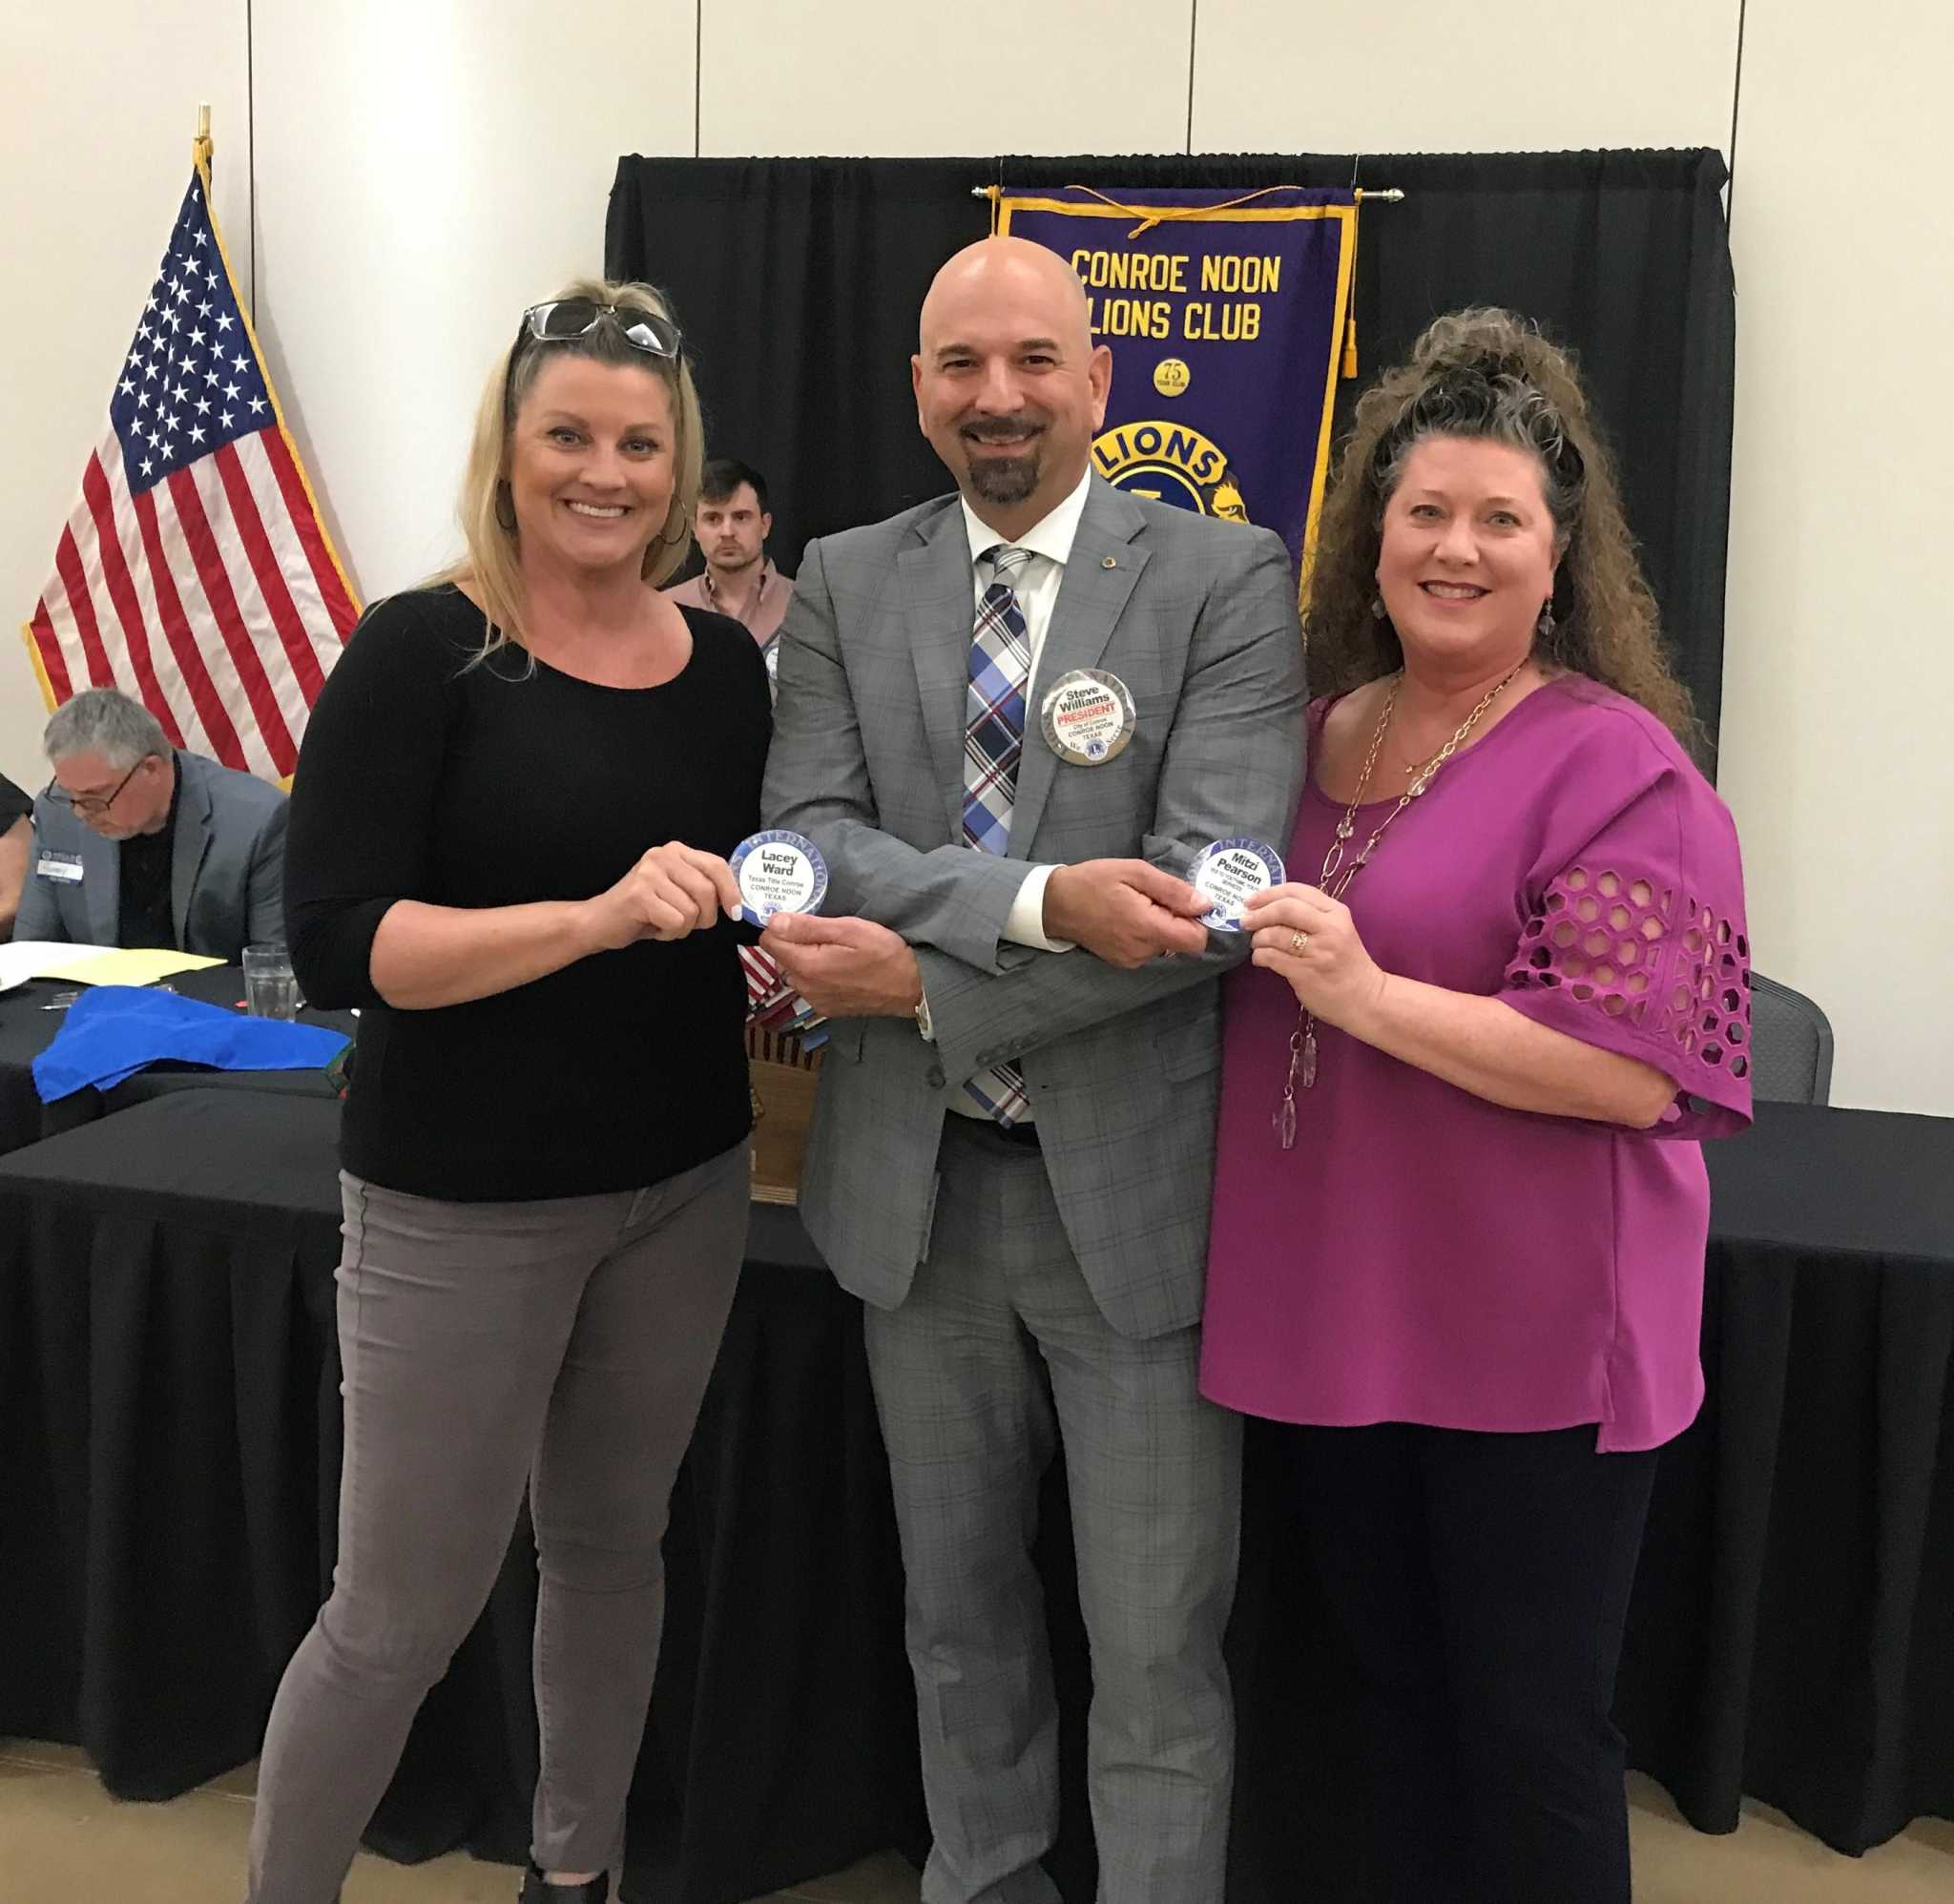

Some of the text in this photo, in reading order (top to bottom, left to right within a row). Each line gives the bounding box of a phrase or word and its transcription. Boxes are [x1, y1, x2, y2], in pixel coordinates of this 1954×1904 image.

[1071, 249, 1282, 294] CONROE NOON
[1087, 298, 1261, 341] LIONS CLUB
[1164, 362, 1182, 381] 75
[1093, 426, 1219, 478] LIONS
[1066, 687, 1099, 700] Steve
[1059, 693, 1110, 713] Williams
[1057, 702, 1115, 725] PRESIDENT
[1069, 721, 1113, 737] CONROE NOON
[1083, 732, 1102, 740] TEXAS
[761, 850, 799, 865] Lacey
[1231, 852, 1259, 871] Mitzi
[763, 862, 794, 876] Ward
[1216, 858, 1261, 885] Pearson
[750, 884, 801, 896] CONROE NOON
[764, 893, 786, 901] TEXAS
[1205, 881, 1232, 897] CONROE
[1215, 893, 1235, 906] TEXAS
